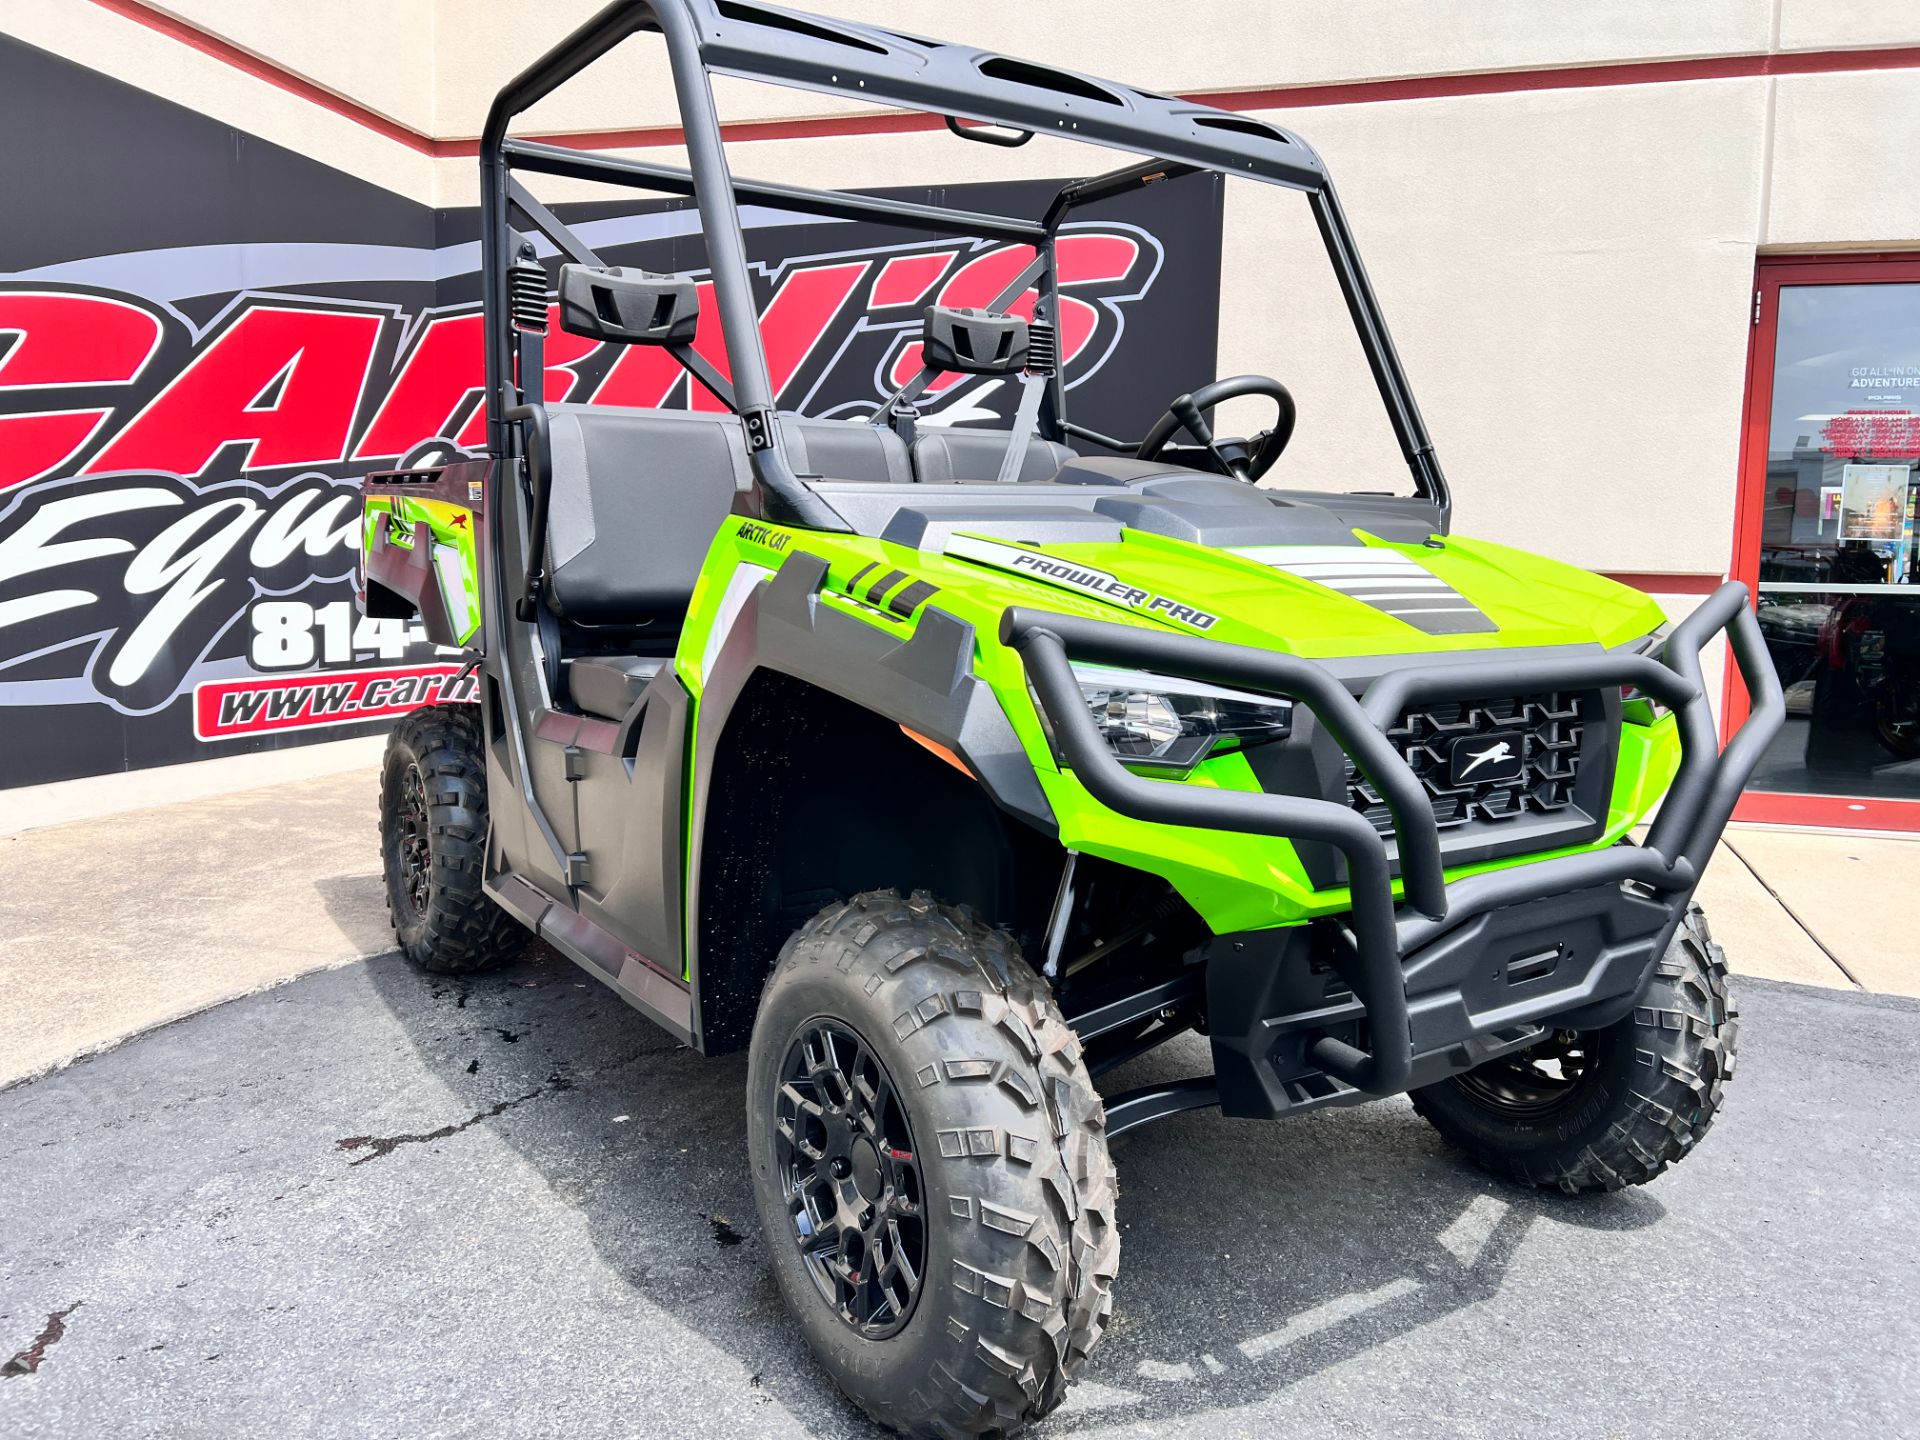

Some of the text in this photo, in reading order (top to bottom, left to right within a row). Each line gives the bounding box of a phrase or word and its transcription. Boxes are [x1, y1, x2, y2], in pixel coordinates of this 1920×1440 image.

[1851, 367, 1868, 377] GO
[1851, 378, 1920, 388] ADVENTURE
[736, 521, 792, 552] ARCTIC CAT
[1012, 555, 1217, 630] PROWLER PRO
[251, 601, 466, 667] 814-
[217, 671, 482, 728] www.carn
